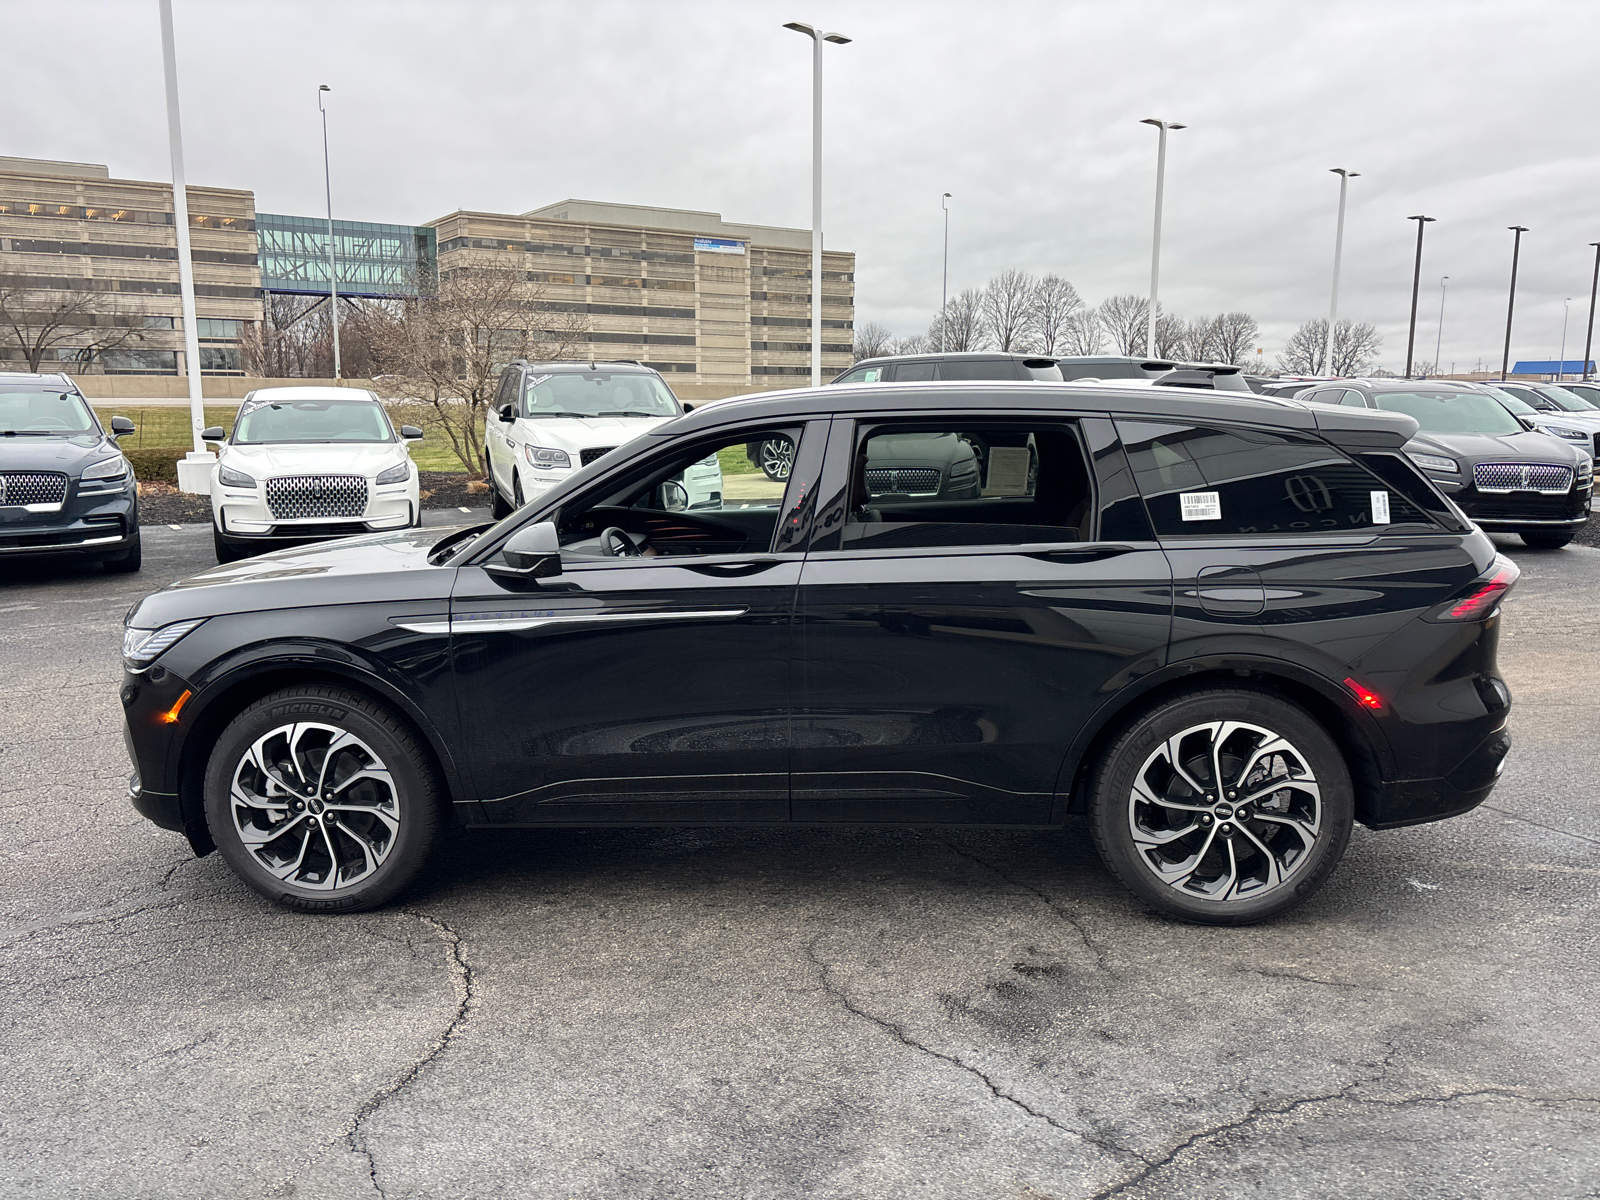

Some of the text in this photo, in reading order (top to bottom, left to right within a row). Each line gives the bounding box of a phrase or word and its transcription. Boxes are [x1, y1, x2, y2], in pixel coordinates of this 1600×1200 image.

[453, 611, 555, 620] NAUTILUS
[271, 703, 345, 719] MICHELIN
[1109, 730, 1152, 802] MICHELIN
